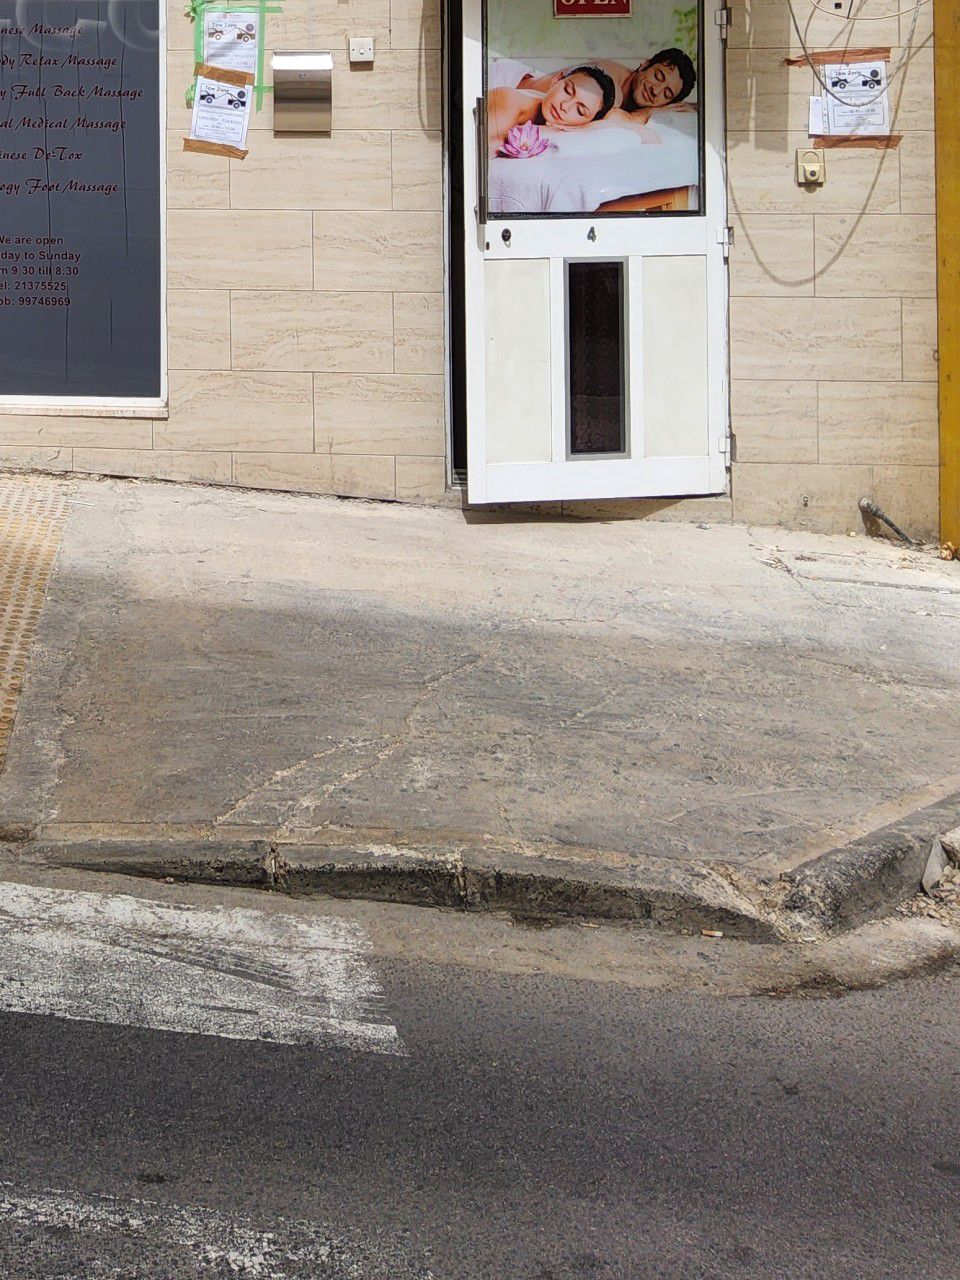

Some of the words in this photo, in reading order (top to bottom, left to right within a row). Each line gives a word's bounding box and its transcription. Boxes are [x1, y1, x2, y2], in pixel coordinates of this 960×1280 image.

[27, 22, 83, 38] Massage
[19, 53, 59, 68] Relax
[61, 53, 118, 69] Massage
[10, 84, 46, 100] Full
[51, 84, 86, 97] Back
[86, 85, 144, 99] Massage
[14, 116, 68, 130] Medical
[69, 116, 127, 132] Massage
[33, 146, 83, 161] De-Tox
[24, 179, 60, 195] Foot
[61, 180, 118, 193] Massage
[14, 237, 32, 245] are
[35, 236, 64, 247] open
[586, 226, 597, 243] 4
[24, 252, 35, 260] to
[38, 251, 81, 263] Sunday
[11, 266, 35, 275] 9:30
[37, 266, 52, 276] till
[55, 266, 79, 276] 8:30
[14, 281, 67, 291] 21375525
[18, 297, 71, 307] 99746969
